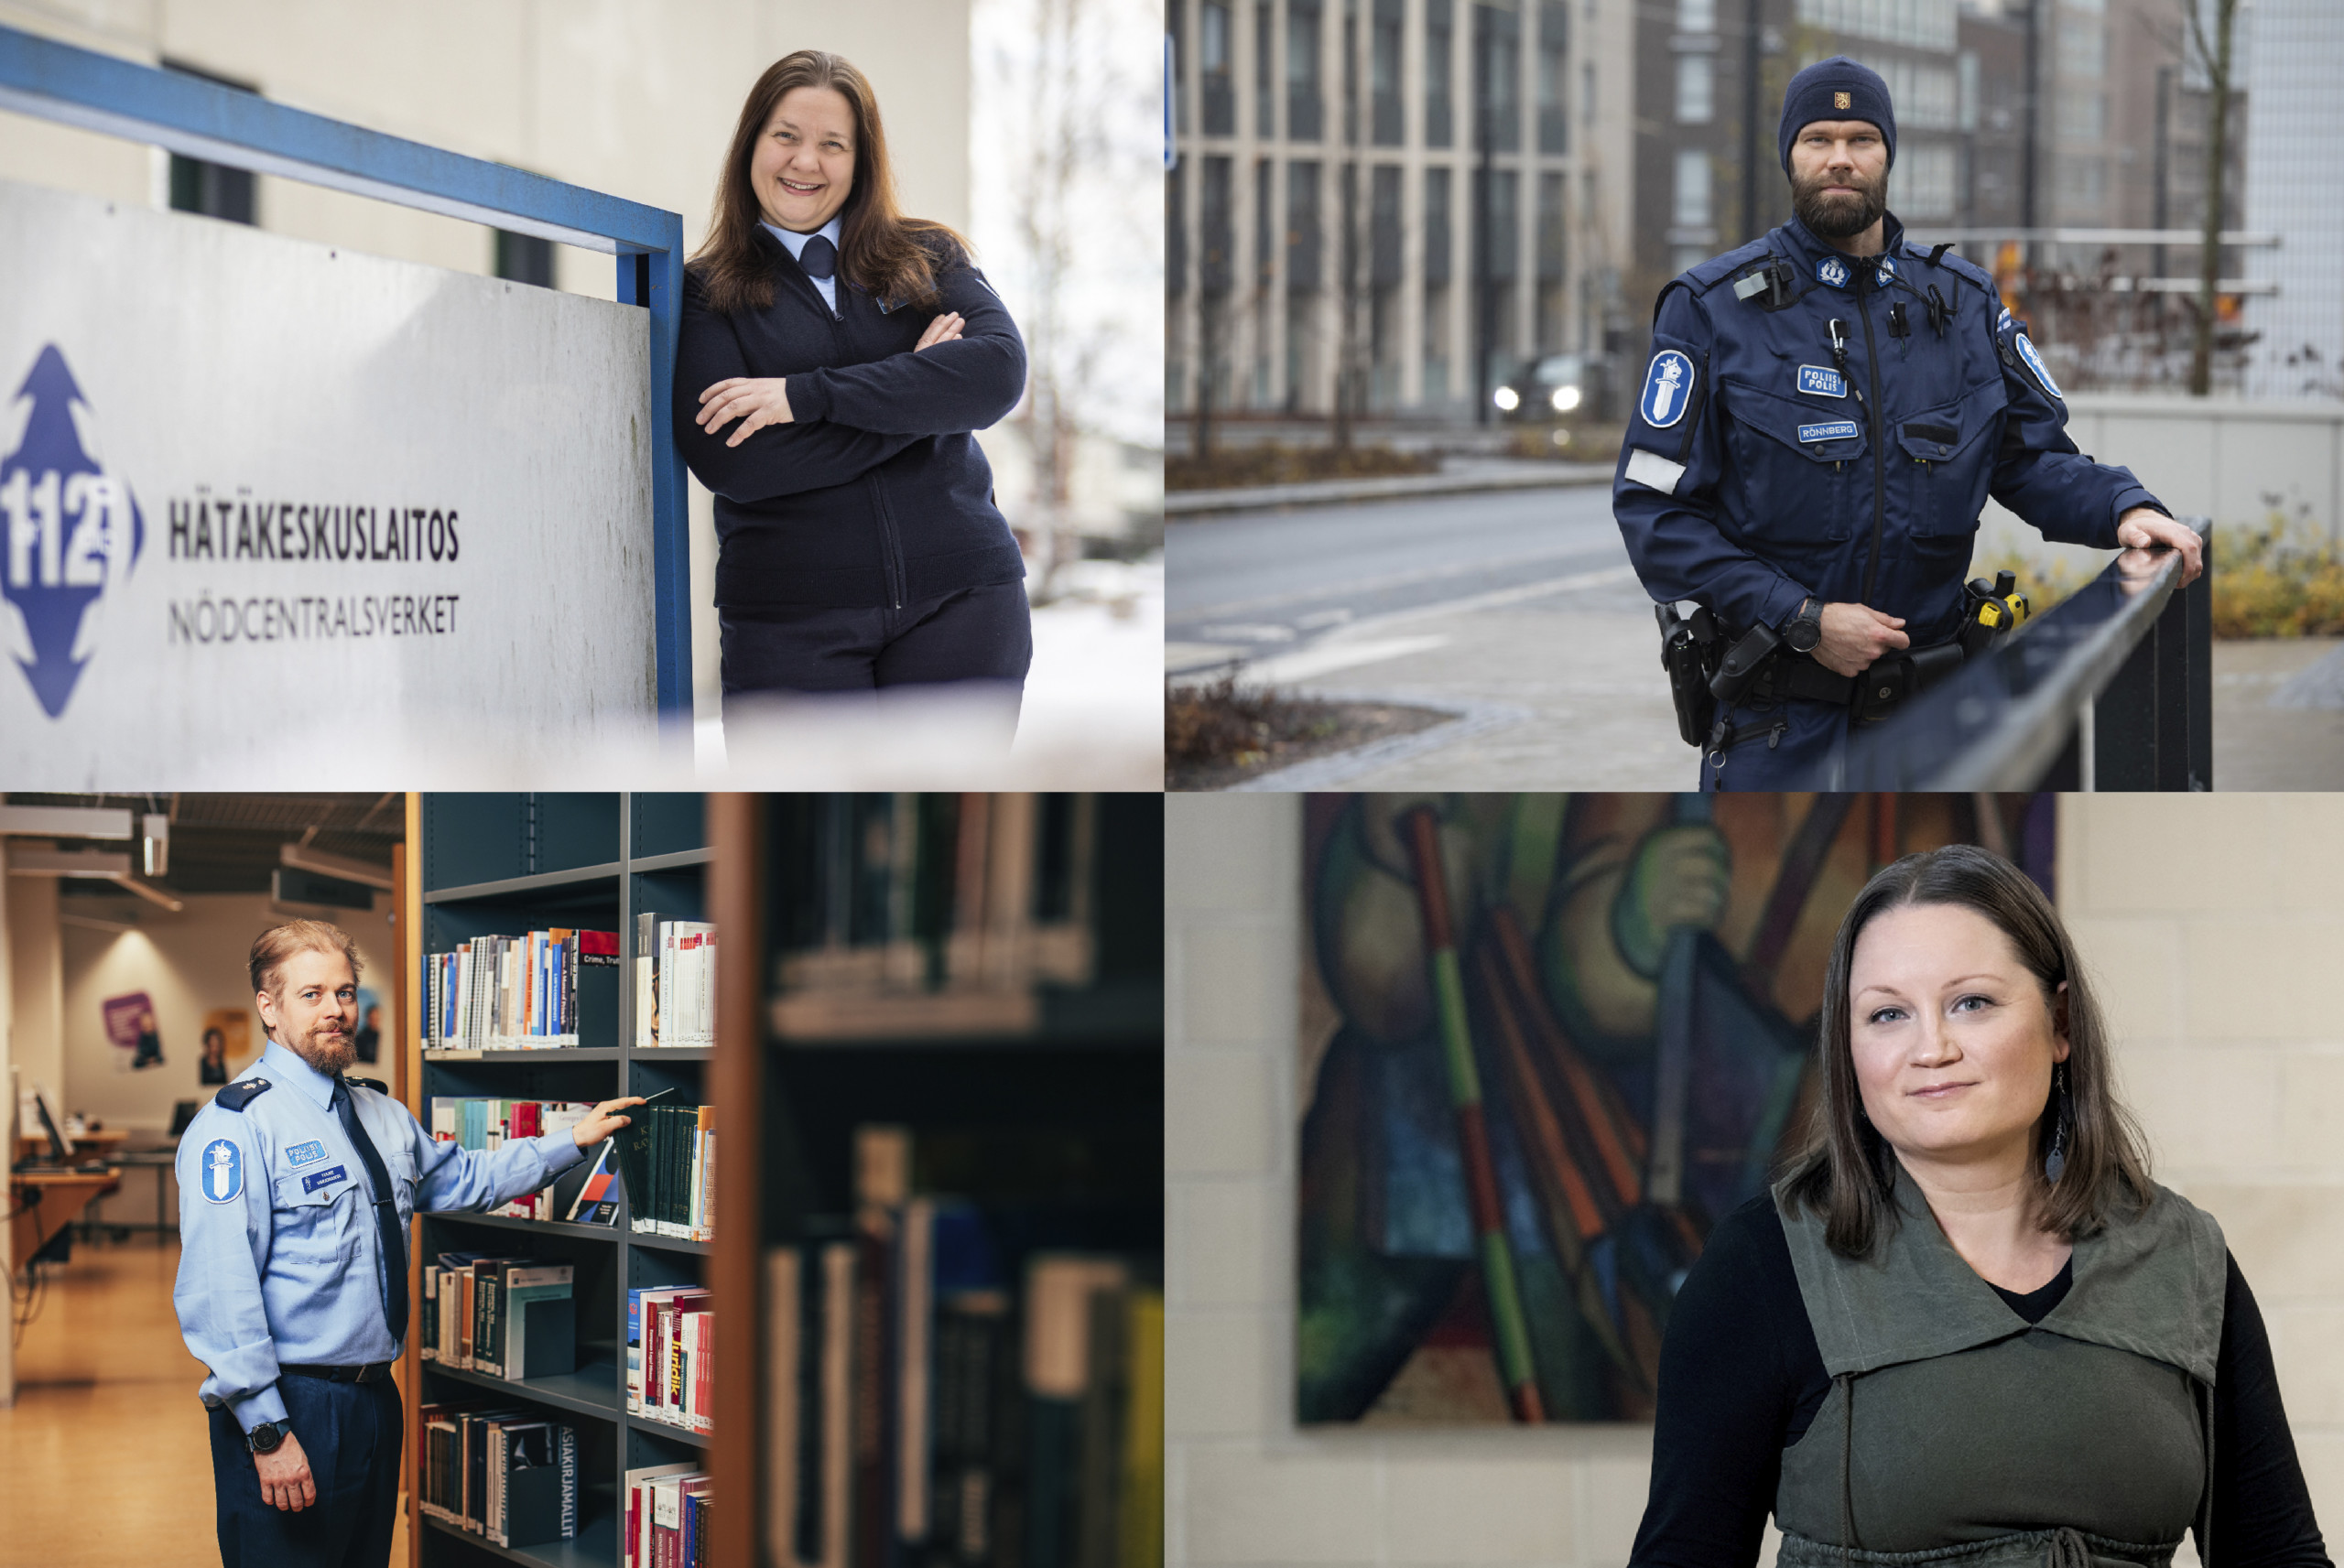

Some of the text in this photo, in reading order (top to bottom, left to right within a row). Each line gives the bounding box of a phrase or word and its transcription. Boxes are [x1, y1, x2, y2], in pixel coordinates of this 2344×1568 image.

[1805, 370, 1841, 385] POLIISI
[1808, 379, 1838, 392] POLIS
[1802, 426, 1853, 438] RÖNNBERG
[0, 469, 104, 587] 112
[168, 485, 460, 561] HÄTÄKESKUSLAITOS
[168, 589, 460, 643] NÖDCENTRALSVERKET
[288, 1143, 319, 1156] POLIISI
[296, 1151, 318, 1162] POLIS
[670, 1336, 682, 1396] Juridik
[560, 1426, 574, 1538] ASIAKIRJAMALLIT
